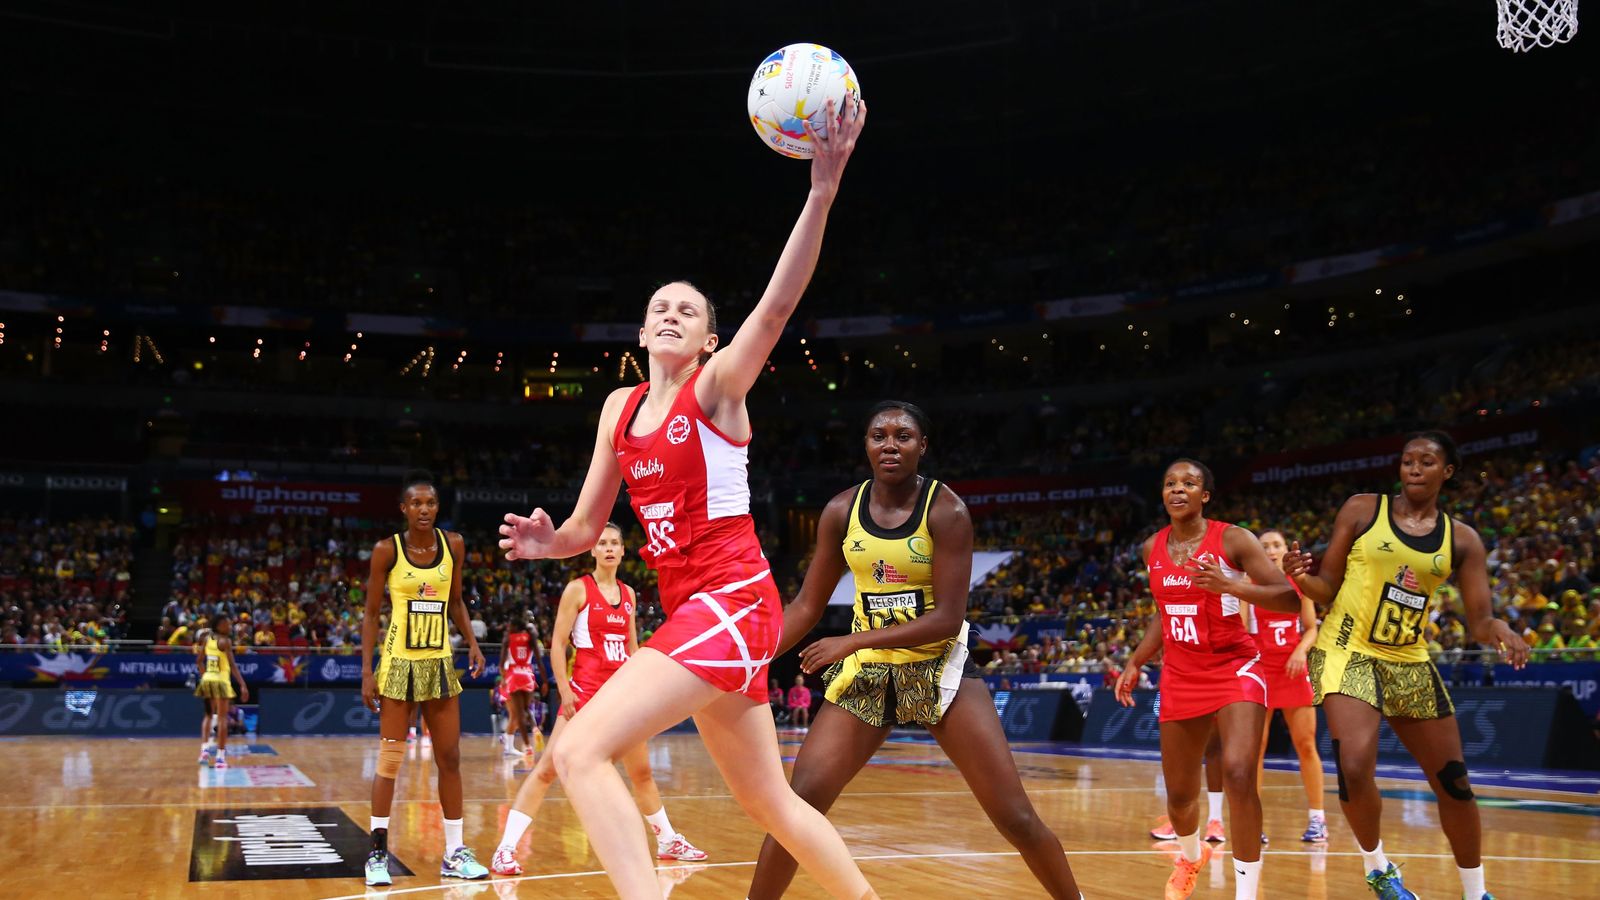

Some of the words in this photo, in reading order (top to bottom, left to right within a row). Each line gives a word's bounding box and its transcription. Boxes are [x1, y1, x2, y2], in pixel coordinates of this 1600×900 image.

[785, 72, 794, 89] 2015
[630, 458, 664, 480] Vitality
[221, 485, 361, 503] allphones
[255, 504, 329, 515] arena
[1163, 574, 1191, 589] Vitality
[870, 596, 914, 608] TELSTRA
[1391, 588, 1424, 607] TELSTRA
[413, 603, 442, 611] TELSTRA
[1166, 606, 1196, 615] TELSTRA
[409, 613, 443, 648] WD
[1170, 617, 1200, 645] GA
[1372, 601, 1422, 644] GK
[1274, 628, 1287, 646] C
[604, 641, 629, 661] WA
[119, 662, 177, 673] NETBALL
